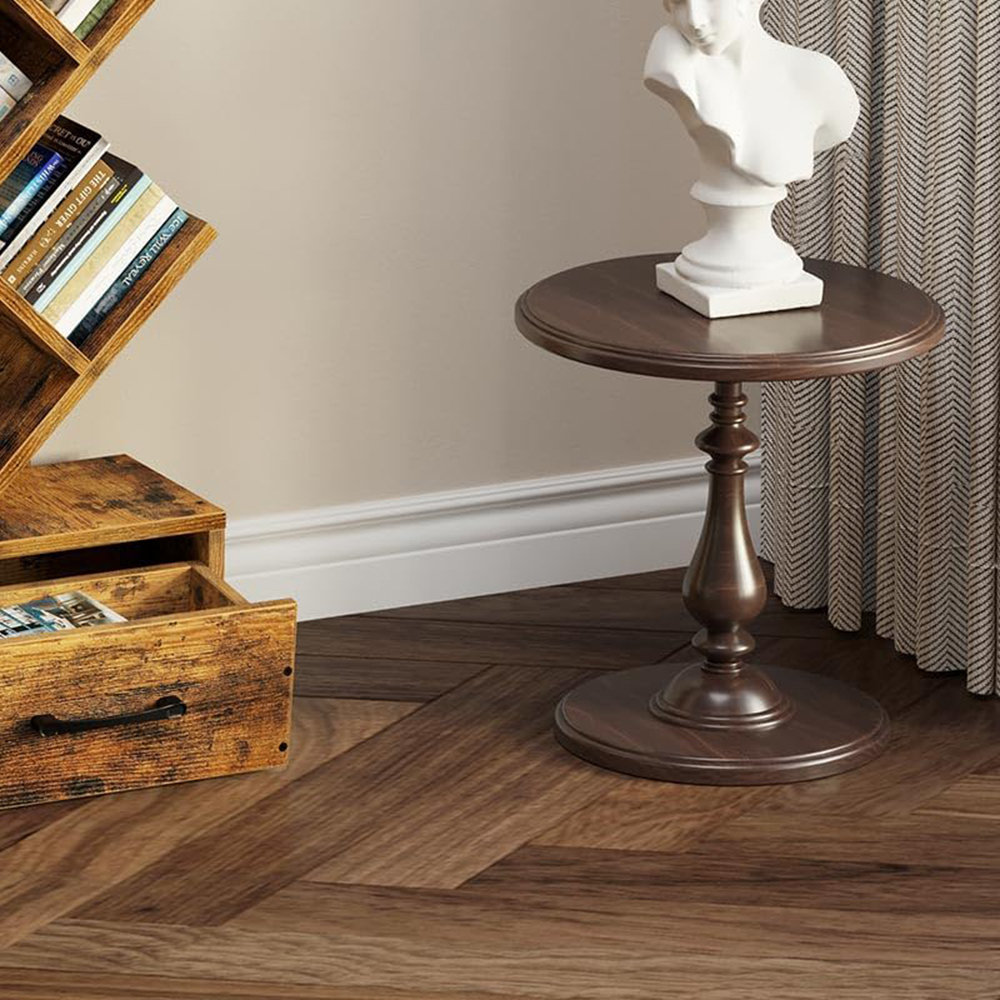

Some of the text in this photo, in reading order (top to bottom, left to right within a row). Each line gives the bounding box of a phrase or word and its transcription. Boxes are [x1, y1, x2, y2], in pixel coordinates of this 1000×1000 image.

[89, 170, 105, 187] THE
[74, 185, 91, 204] GIFT
[55, 203, 76, 226] GIVER
